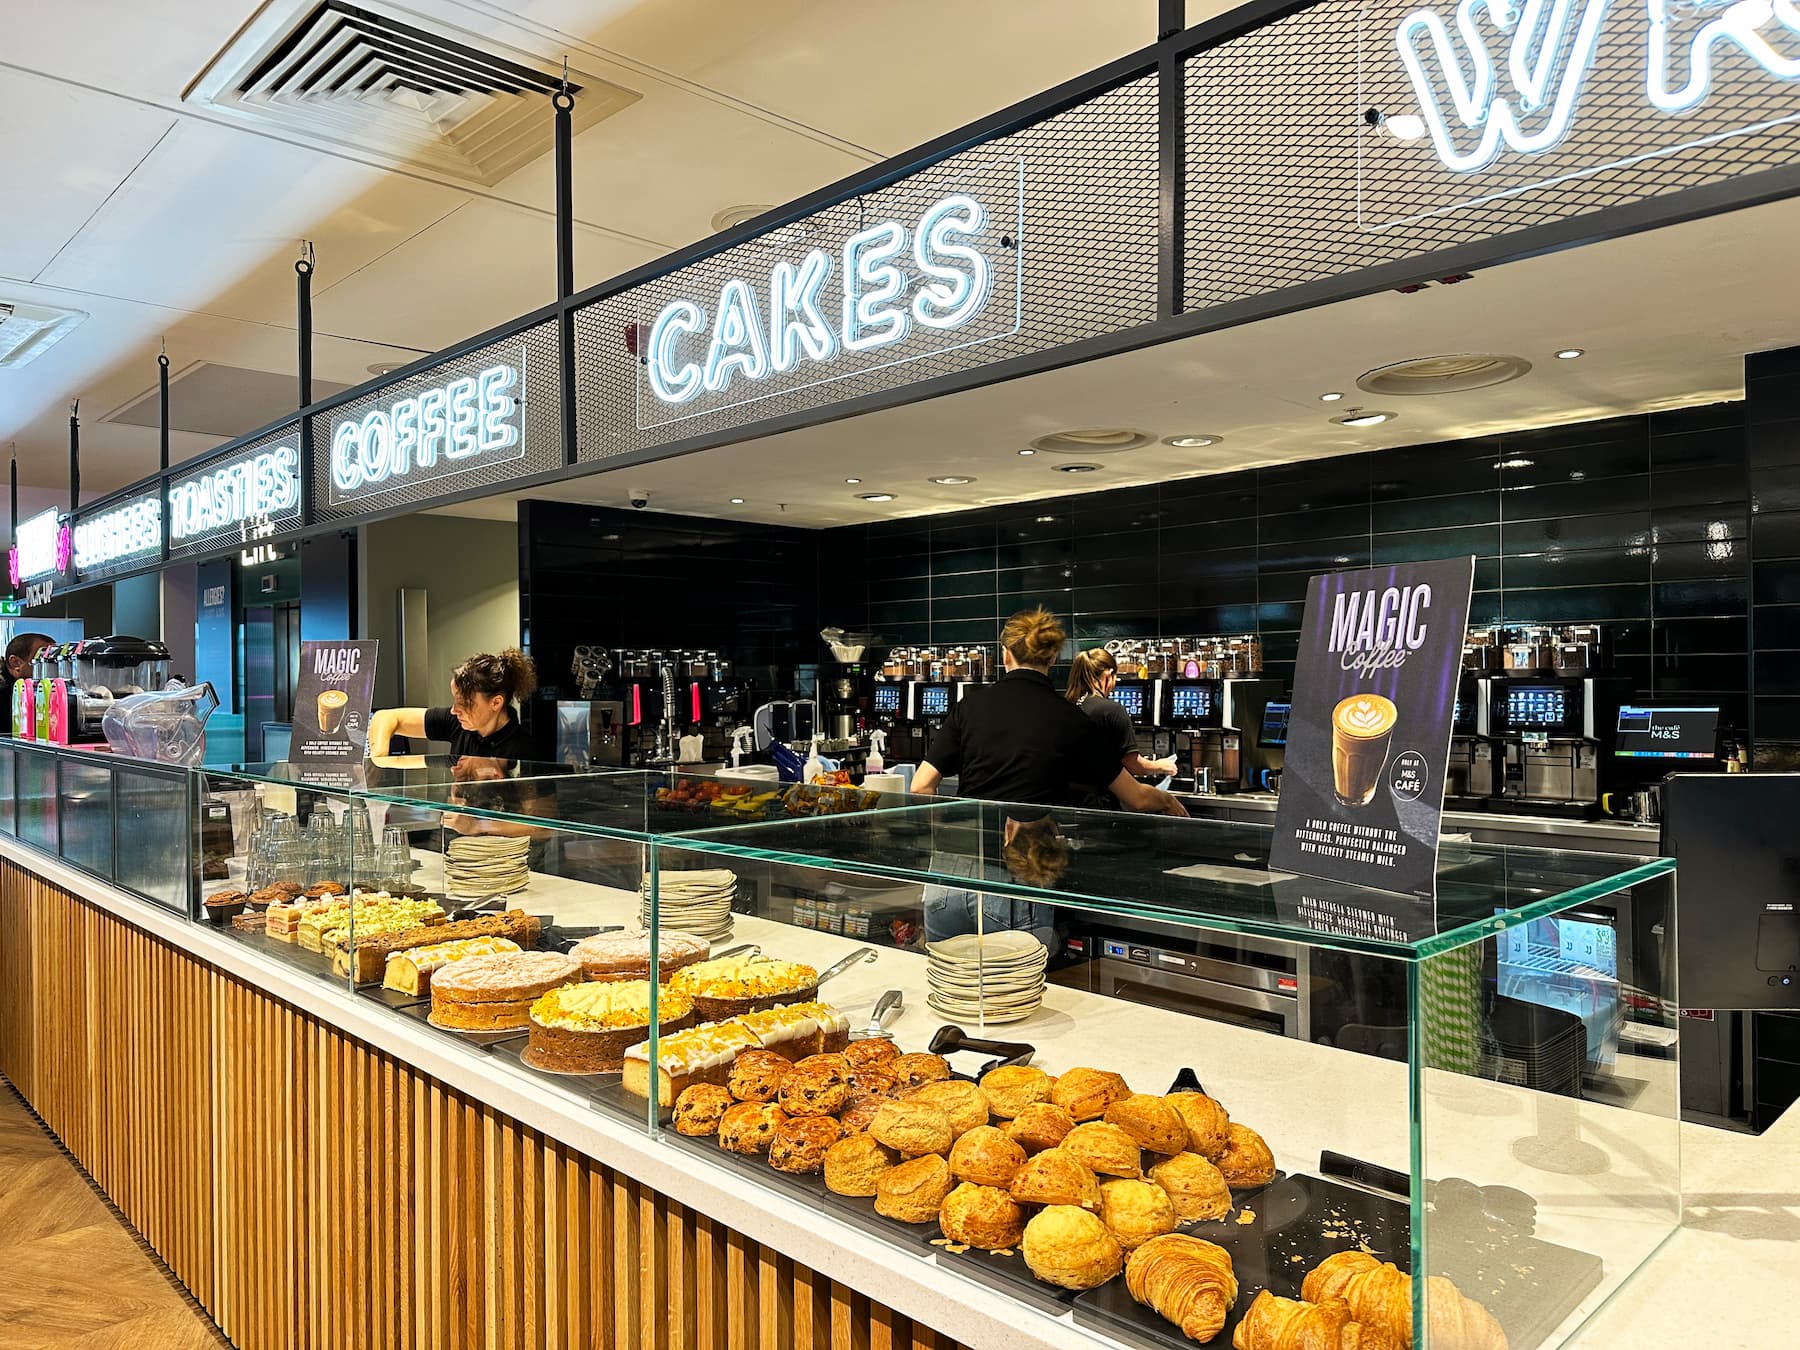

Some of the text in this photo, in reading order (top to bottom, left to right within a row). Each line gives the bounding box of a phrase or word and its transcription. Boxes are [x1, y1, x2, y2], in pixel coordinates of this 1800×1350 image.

[648, 194, 995, 405] CAKES
[331, 363, 518, 491] COFFEE
[168, 445, 298, 539] TOASTIES
[25, 580, 53, 609] PICK-UP
[1328, 583, 1432, 653] MAGIC
[314, 648, 361, 674] MAGIC
[320, 671, 351, 685] Coffee
[1651, 731, 1680, 739] M&S
[1395, 779, 1421, 792] CAFÉ
[1401, 770, 1417, 779] M&S
[1305, 818, 1398, 841] A BOLD COFFEE WITHOUT THE
[1300, 841, 1396, 867] WITH VELVETY STEAMED MILK.
[1335, 835, 1371, 850] PERFECTLY
[1372, 841, 1407, 856] BALANCED
